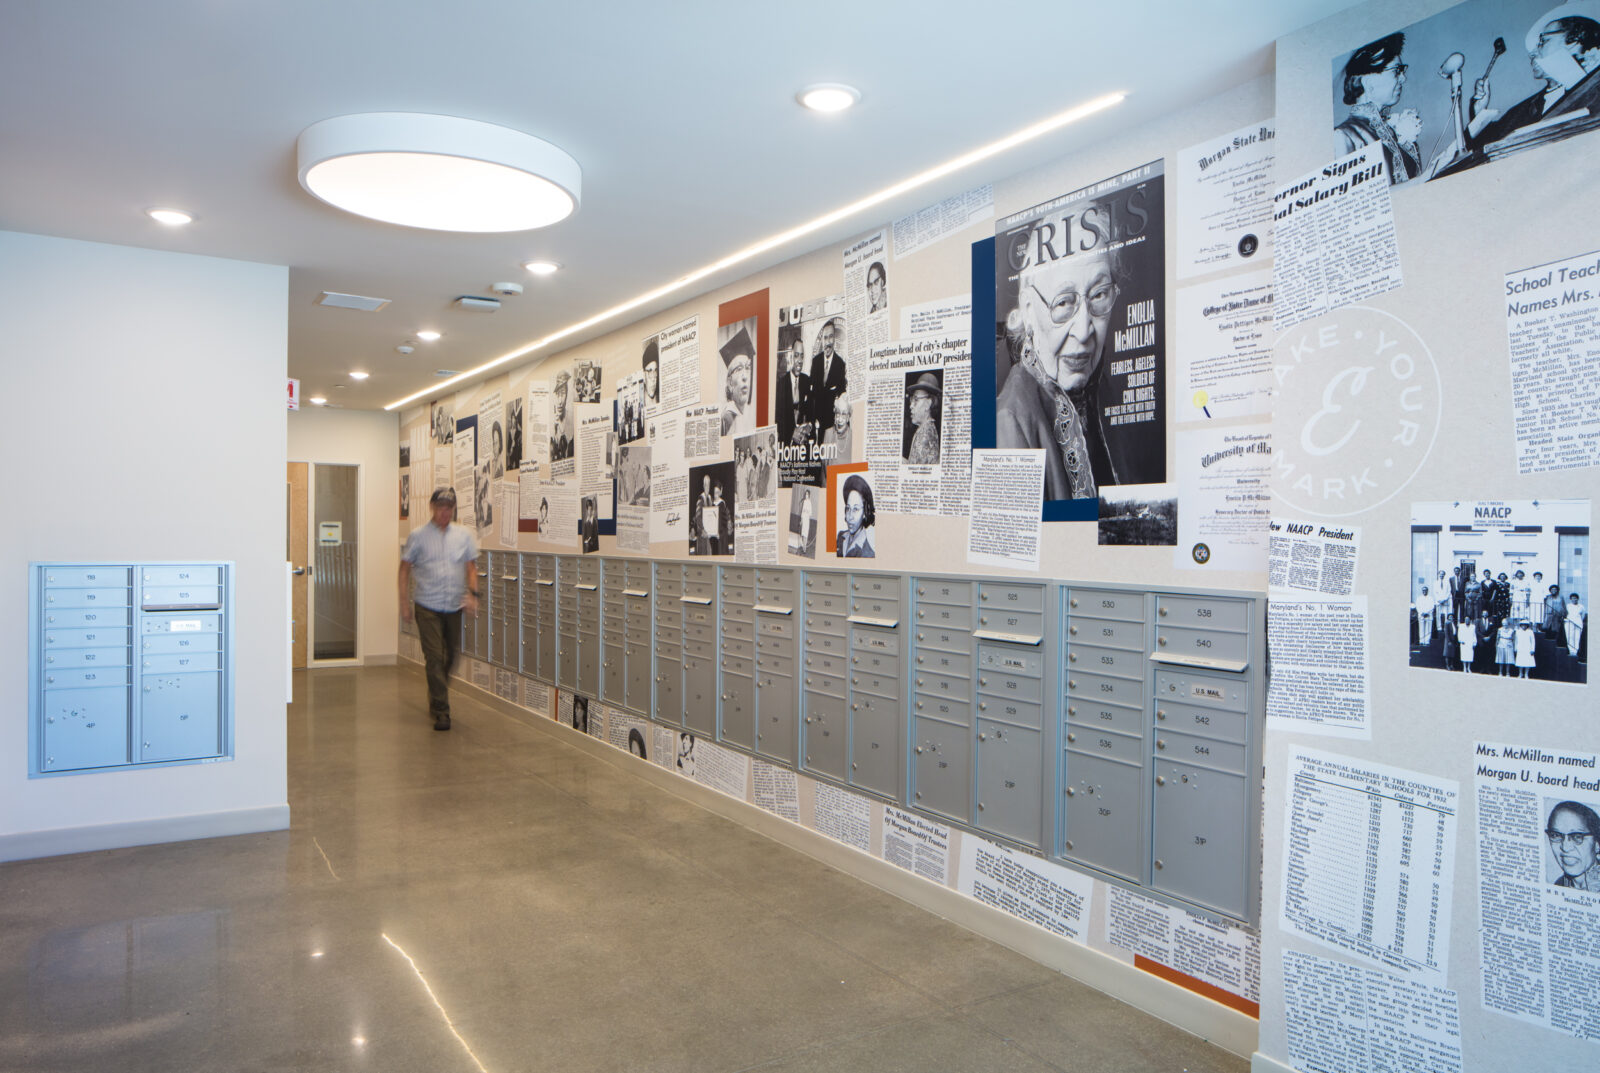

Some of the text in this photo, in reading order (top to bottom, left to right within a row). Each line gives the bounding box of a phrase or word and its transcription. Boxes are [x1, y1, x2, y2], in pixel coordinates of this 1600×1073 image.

[1198, 146, 1231, 171] Morgan
[1232, 134, 1256, 150] State
[1322, 155, 1366, 180] Signs
[1295, 182, 1348, 211] Salary
[1352, 162, 1382, 186] Bill
[1006, 208, 1033, 225] NAACP'S
[1088, 187, 1095, 196] IS
[1098, 180, 1119, 192] MINE,
[1122, 170, 1142, 184] PART
[1008, 190, 1149, 272] CRISIS
[1109, 236, 1146, 251] AND IDEAS
[1506, 271, 1552, 296] School
[1508, 288, 1594, 317] Names Mrs.
[1128, 299, 1155, 326] ENOLIA
[1525, 318, 1546, 327] Booker
[1559, 307, 1598, 318] Washington
[1114, 323, 1155, 352] McMILLAN
[1510, 329, 1532, 337] teacher
[1510, 329, 1595, 350] trustees Public
[1527, 332, 1555, 340] Tuesday,
[870, 338, 968, 358] Longtime head of city's chapter
[1546, 339, 1584, 350] Association,
[870, 359, 889, 371] elected
[890, 356, 915, 368] national
[917, 353, 942, 366] NAACP
[1111, 355, 1155, 376] FEARLESS, AGELESS
[1128, 370, 1155, 388] SOLDIER OF
[1513, 364, 1594, 383] Maryland school system
[1123, 389, 1135, 403] CIVIL
[1376, 330, 1423, 446] YOUR
[1570, 391, 1596, 400] Charles
[777, 440, 837, 461] Home Team
[1202, 446, 1244, 468] University
[1246, 443, 1255, 453] of
[1562, 454, 1591, 462] Teachers
[1272, 449, 1378, 500] MARK
[1549, 461, 1590, 471] instrumental
[1474, 507, 1512, 518] NAACP
[1287, 523, 1313, 535] NAACP
[1318, 527, 1354, 540] President
[1102, 600, 1114, 608] 530
[1197, 609, 1211, 617] 538
[1197, 640, 1211, 648] 540
[1101, 656, 1114, 665] 533
[1100, 712, 1112, 720] 535
[1195, 716, 1210, 725] 542
[1100, 740, 1112, 748] 536
[1195, 746, 1210, 755] 544
[1476, 744, 1596, 768] Mrs. McMillan named
[1296, 755, 1322, 765] AVERAGE
[1324, 762, 1349, 772] ANNUAL
[1351, 768, 1379, 779] SALARIES
[1392, 777, 1406, 786] THE
[1408, 782, 1444, 795] COUNTIES
[1317, 767, 1336, 776] STATE
[1339, 771, 1381, 786] ELEMENTARY
[1384, 783, 1414, 794] SCHOOLS
[1417, 791, 1430, 799] FOR
[1477, 765, 1600, 791] Morgan U. board head
[1394, 793, 1414, 802] Colored
[892, 819, 907, 832] Morgan
[1026, 868, 1077, 897] reappointed member
[1049, 886, 1072, 901] University
[1433, 987, 1456, 996] NAACP
[1384, 1010, 1405, 1019] NAACP
